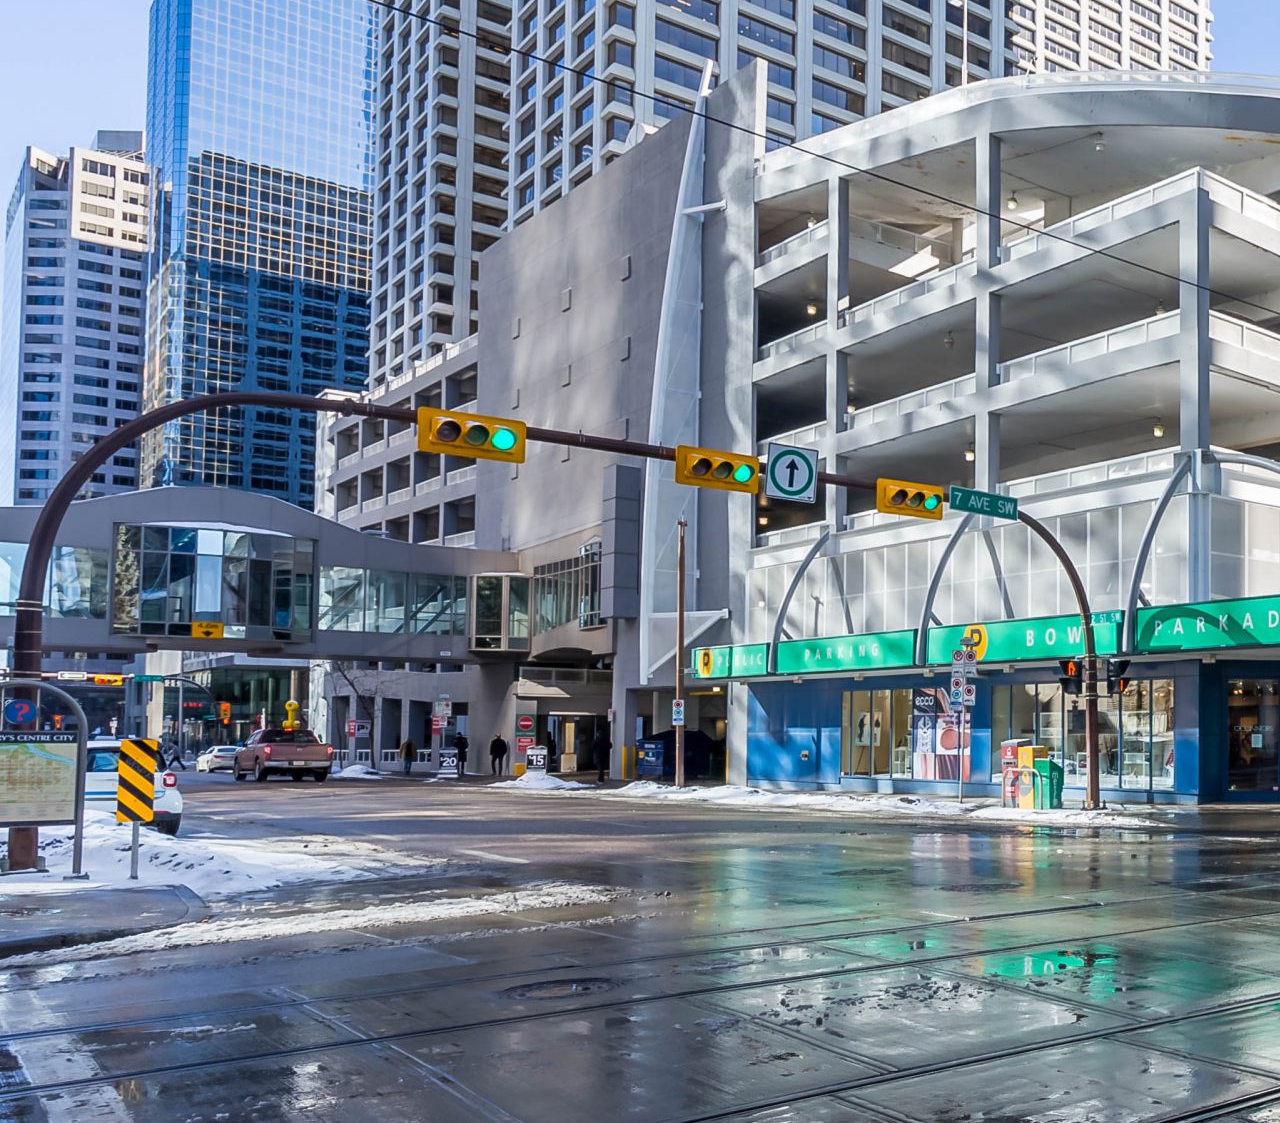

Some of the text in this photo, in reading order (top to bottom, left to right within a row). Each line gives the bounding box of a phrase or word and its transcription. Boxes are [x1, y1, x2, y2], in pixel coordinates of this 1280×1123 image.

[953, 491, 1015, 515] 7 AVE SW
[1100, 613, 1107, 623] ST
[1111, 612, 1121, 622] SW
[1026, 625, 1084, 647] BOW
[703, 643, 880, 667] P PUBLIC PARKING
[915, 696, 934, 706] ecco
[17, 734, 51, 742] CENTRE
[53, 734, 74, 742] CITY
